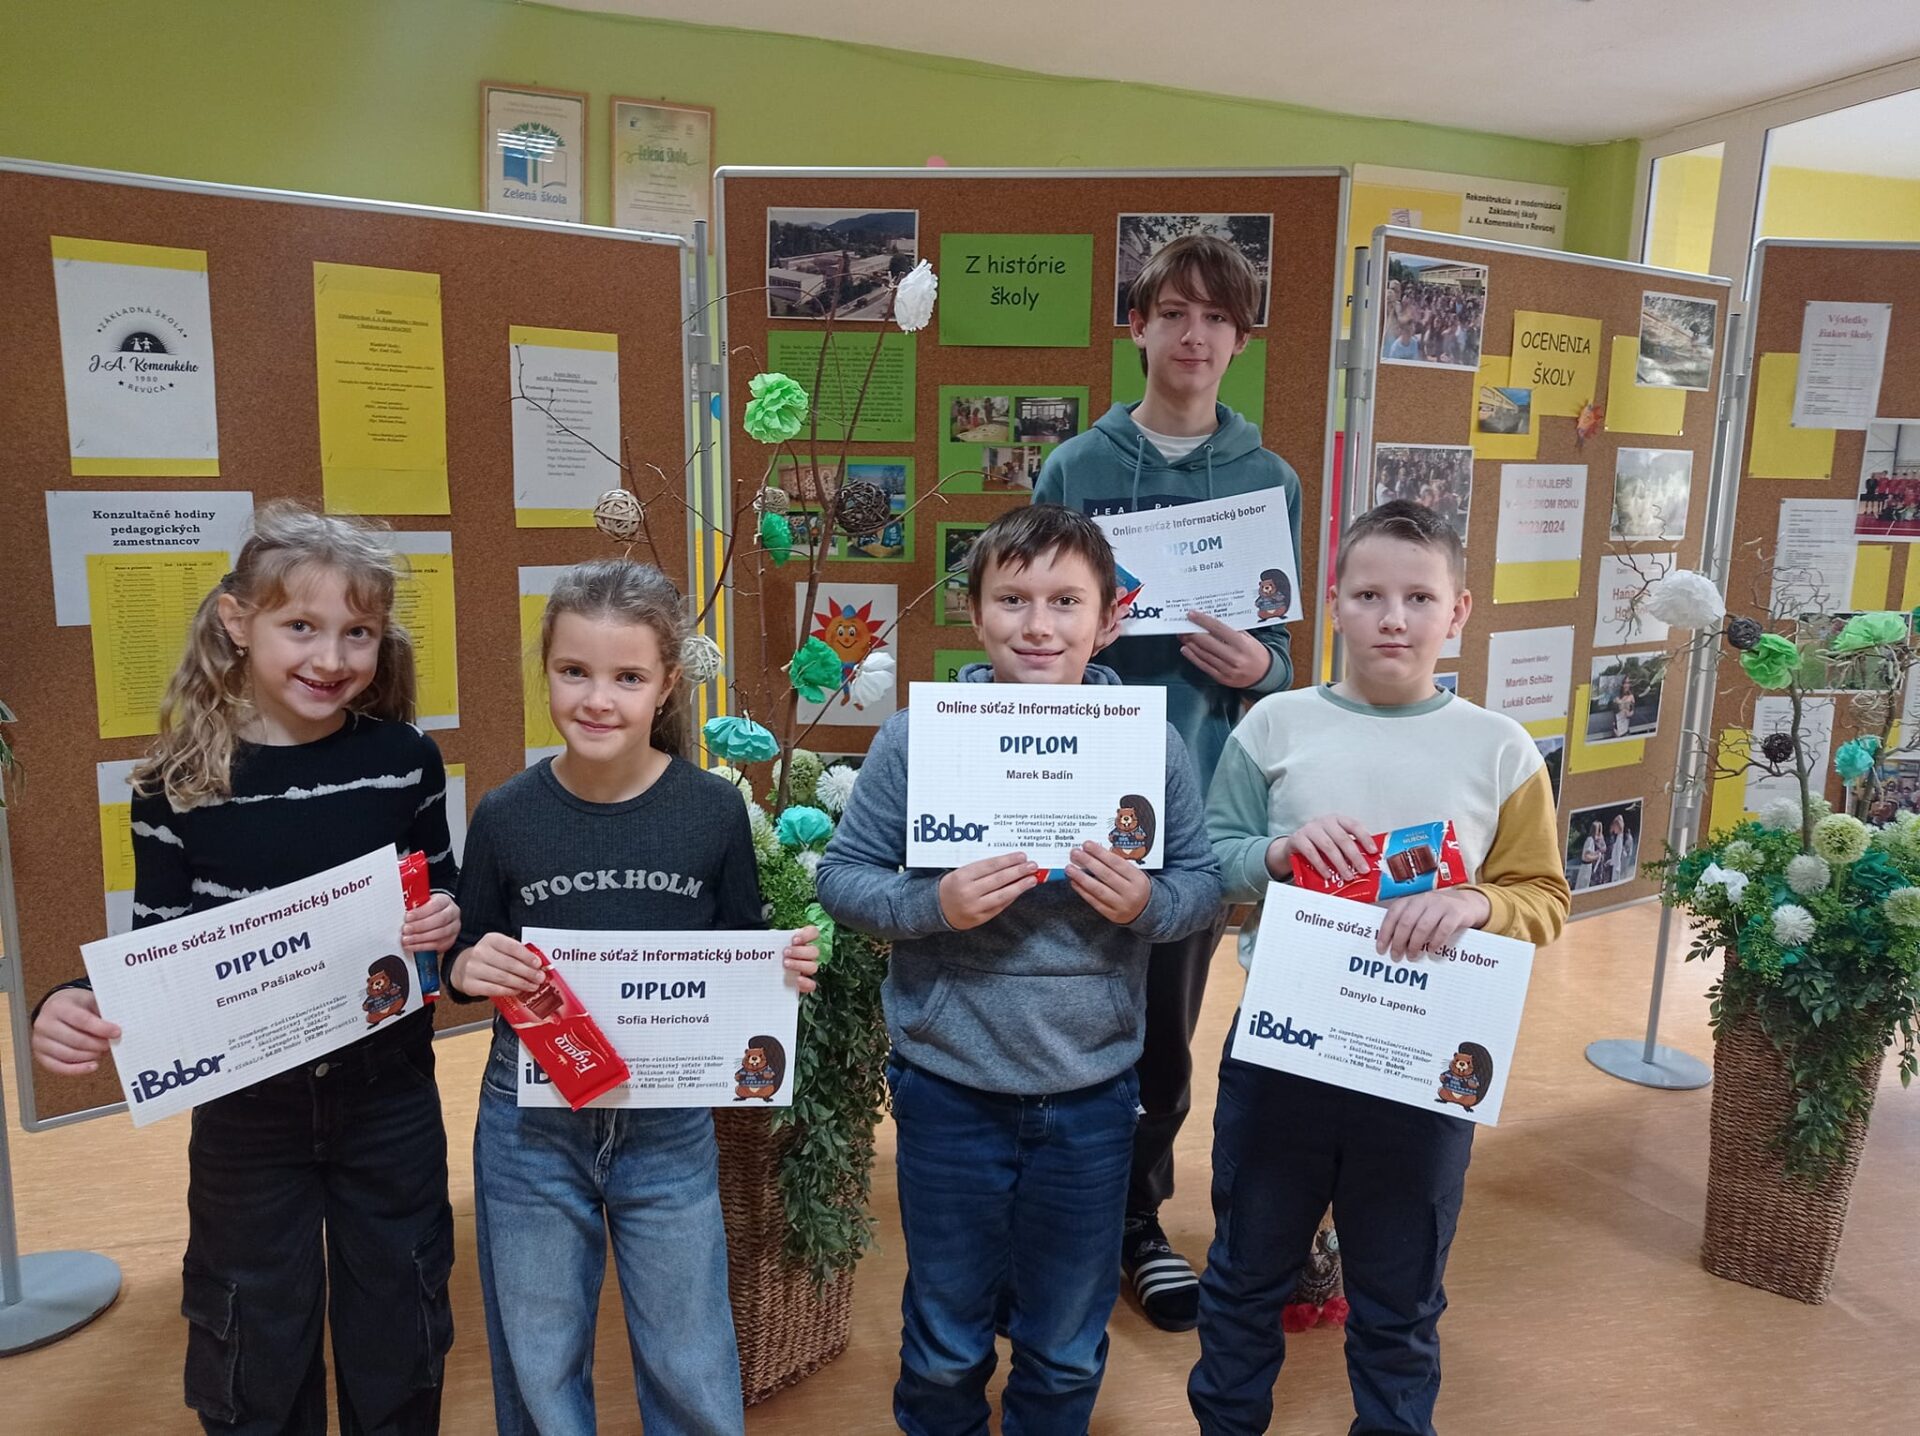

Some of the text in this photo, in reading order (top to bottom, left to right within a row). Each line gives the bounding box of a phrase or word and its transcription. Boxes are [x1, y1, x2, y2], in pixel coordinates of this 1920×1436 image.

[503, 188, 567, 204] Zelená škola
[965, 253, 1066, 275] Z histórie
[989, 286, 1040, 311] školy
[155, 309, 184, 333] ŠKOLA
[1521, 329, 1591, 355] OCENENIA
[1533, 363, 1576, 387] ŠKOLY
[93, 510, 216, 520] Konzultačné hodiny
[1112, 526, 1143, 536] Online
[1173, 509, 1236, 529] Informatický
[1238, 505, 1267, 517] bobor
[111, 524, 200, 536] pedagogických
[113, 538, 200, 546] zamestnancov
[1168, 536, 1223, 556] IPLOM
[1128, 602, 1163, 619] obor
[1506, 678, 1528, 688] Martin
[937, 701, 1141, 718] Online súťaž Informatický bobor
[1000, 736, 1078, 755] DIPLOM
[1006, 770, 1073, 780] Marek Badín
[913, 813, 989, 843] iBobor
[520, 869, 704, 906] STOCKHOLM
[125, 874, 373, 967] Online súťaž Informatický bobor
[1295, 909, 1499, 968] Online súťaž bobor
[214, 931, 312, 981] DIPLOM
[552, 948, 775, 963] Online súťaž Informatický bobor
[1349, 956, 1429, 990] DIPLOM
[216, 987, 258, 1008] Emma
[621, 981, 706, 1001] DIPLOM
[1340, 987, 1427, 1016] Danylo Lapenko
[617, 1013, 710, 1025] Sofia Herichová
[1249, 1010, 1324, 1050] iBobor
[554, 1033, 598, 1074] Figaro
[130, 1052, 226, 1103] iBobor
